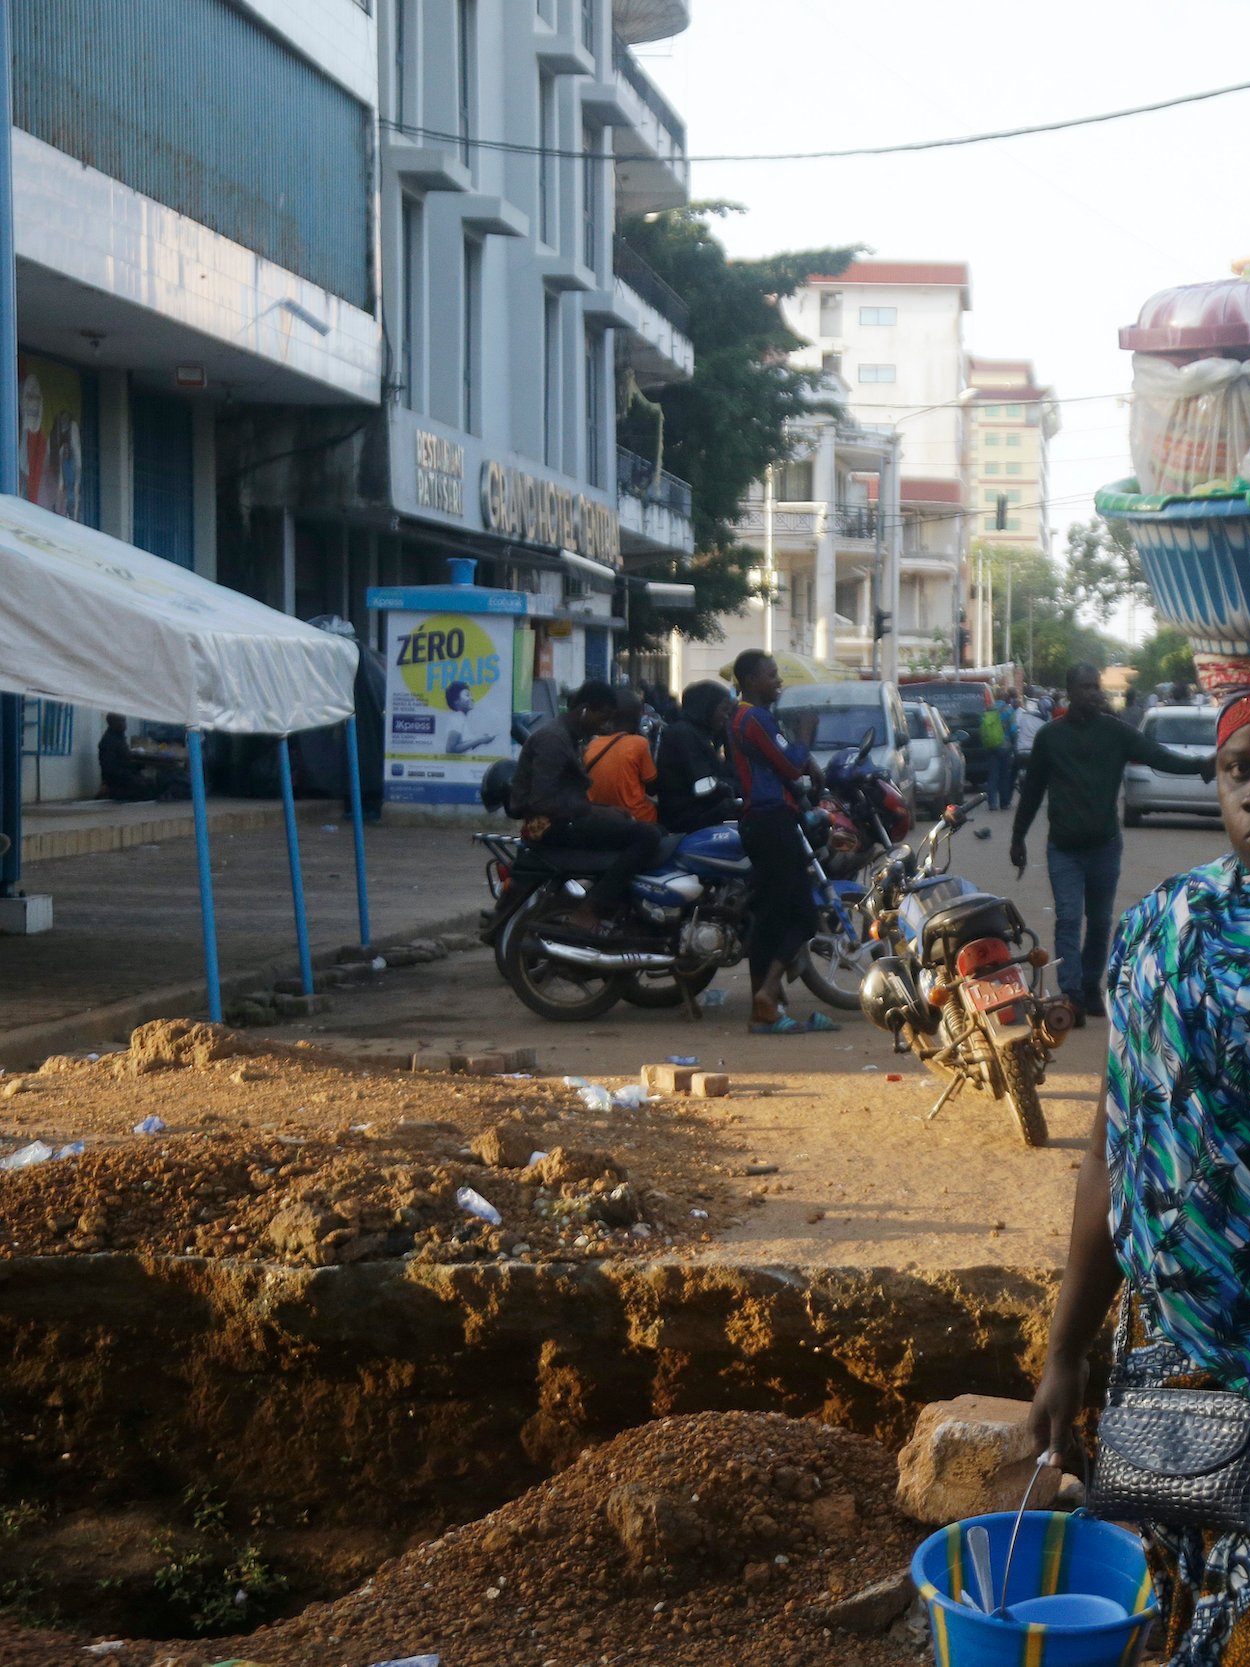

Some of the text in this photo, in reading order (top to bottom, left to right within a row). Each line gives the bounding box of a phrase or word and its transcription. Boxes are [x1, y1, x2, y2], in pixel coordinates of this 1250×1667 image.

[397, 625, 465, 666] ZÉRO
[426, 654, 501, 692] FRAIS
[712, 832, 730, 840] TVS
